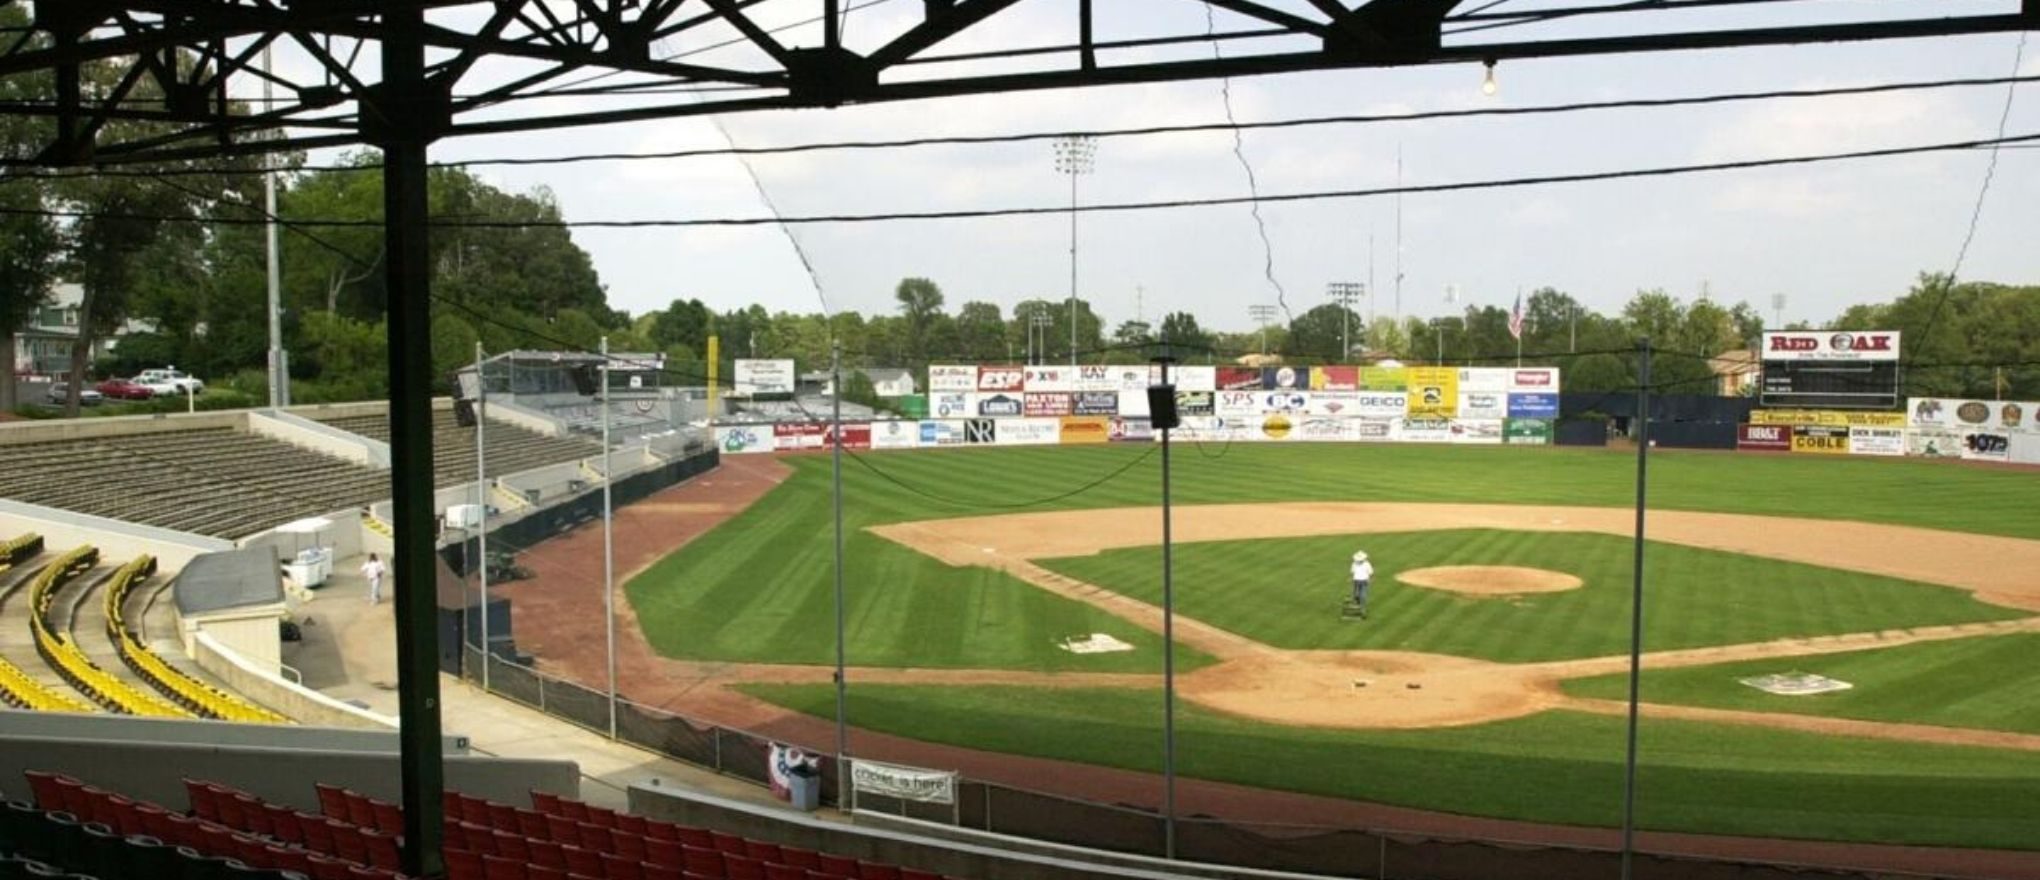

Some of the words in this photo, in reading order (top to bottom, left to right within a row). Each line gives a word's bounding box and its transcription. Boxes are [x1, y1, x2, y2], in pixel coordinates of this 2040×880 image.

[1770, 336, 1818, 351] RED
[1830, 333, 1891, 351] OAK
[1223, 392, 1255, 405] SPS
[1360, 397, 1405, 406] GEICO
[965, 419, 995, 443] NR
[1747, 427, 1781, 440] BB&T
[1796, 437, 1846, 449] COBLE
[899, 777, 910, 788] is
